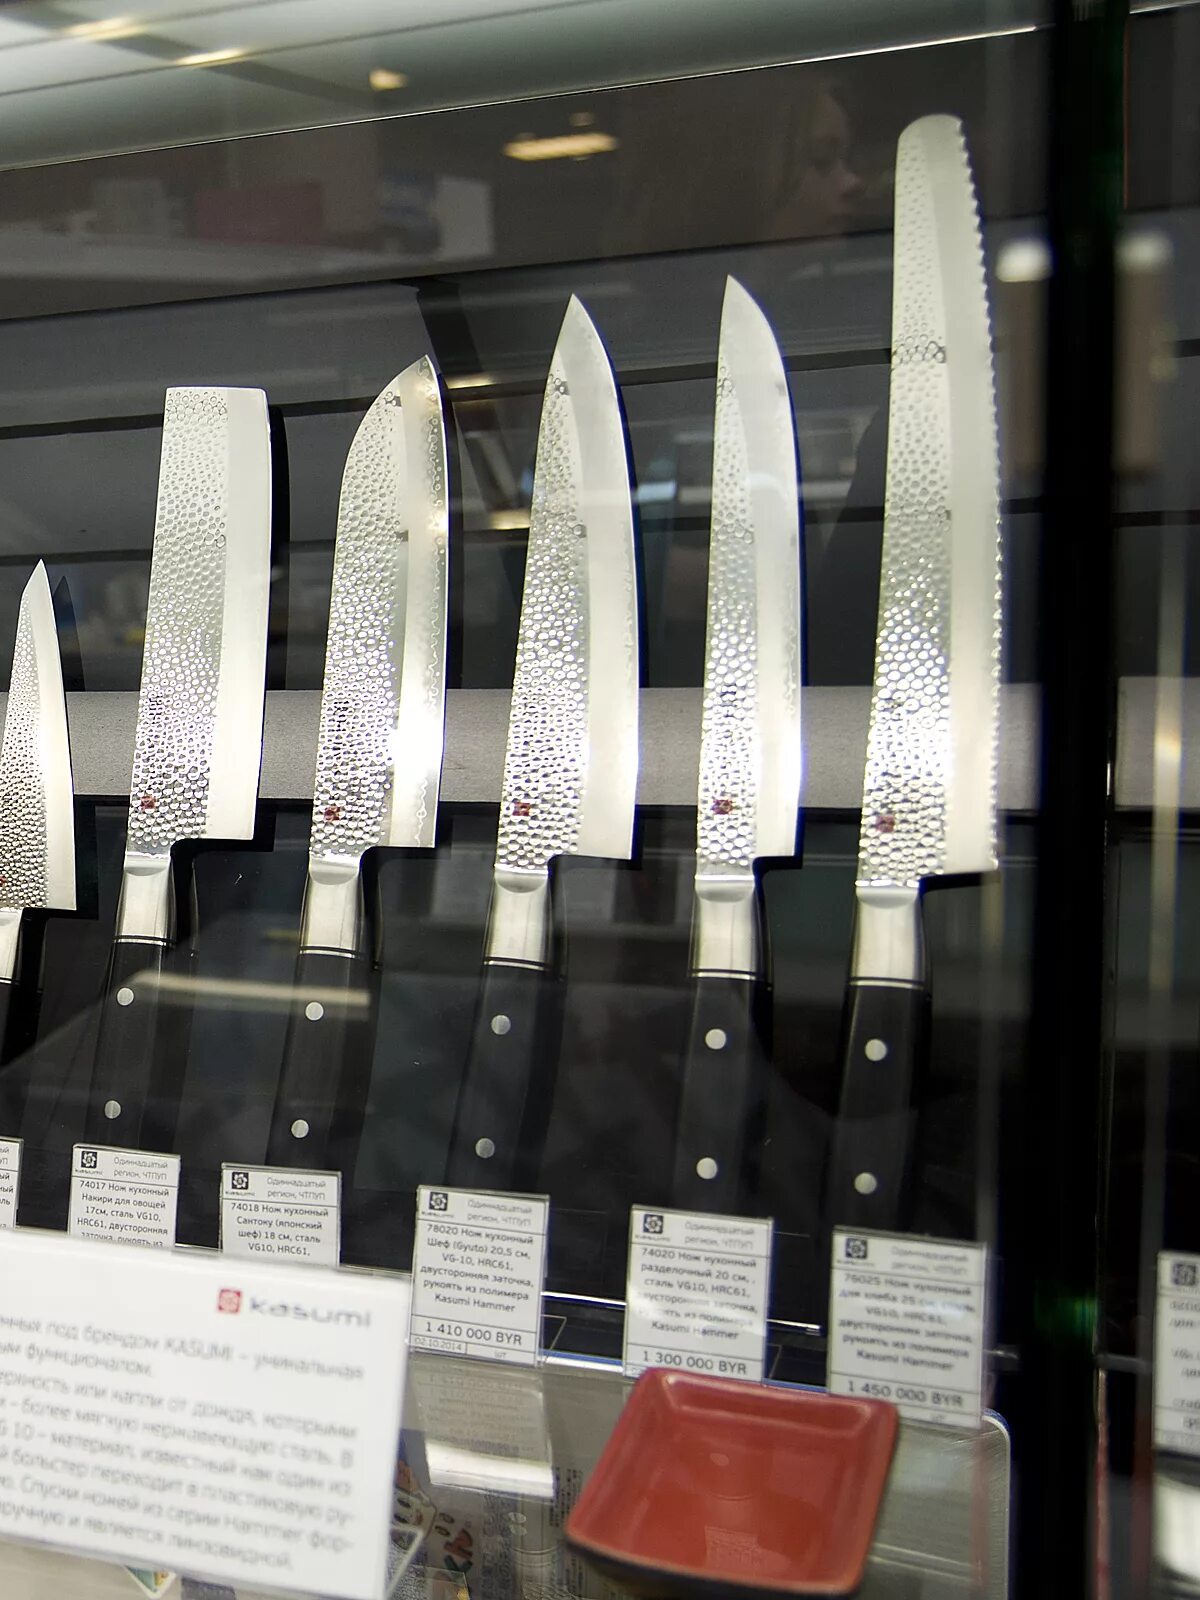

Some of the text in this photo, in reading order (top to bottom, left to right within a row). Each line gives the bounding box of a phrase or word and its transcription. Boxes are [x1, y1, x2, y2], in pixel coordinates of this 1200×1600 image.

[80, 1180, 170, 1196] 74017 Нож кухонный
[81, 1193, 166, 1209] Накири для овощей
[110, 1209, 134, 1218] сталь
[231, 1202, 328, 1217] 74018 Нож кухонный
[108, 1222, 168, 1235] двусторонняя
[236, 1216, 322, 1230] Сантоку (японский
[238, 1230, 262, 1239] шеф)
[265, 1231, 275, 1239] 18
[295, 1235, 321, 1244] сталь
[426, 1223, 534, 1245] 78020 Нож кухонный
[427, 1238, 450, 1249] Шеф
[453, 1241, 488, 1254] (Gyuto)
[678, 1252, 701, 1262] Нож
[704, 1256, 757, 1268] кухонный
[434, 1293, 516, 1313] Kasumi Hammer
[249, 1296, 372, 1328] kasumi
[425, 1321, 522, 1346] 1 410 000 BYR
[643, 1350, 747, 1375] 1 300 000 BYR
[848, 1380, 963, 1408] 1 450 000 BYR
